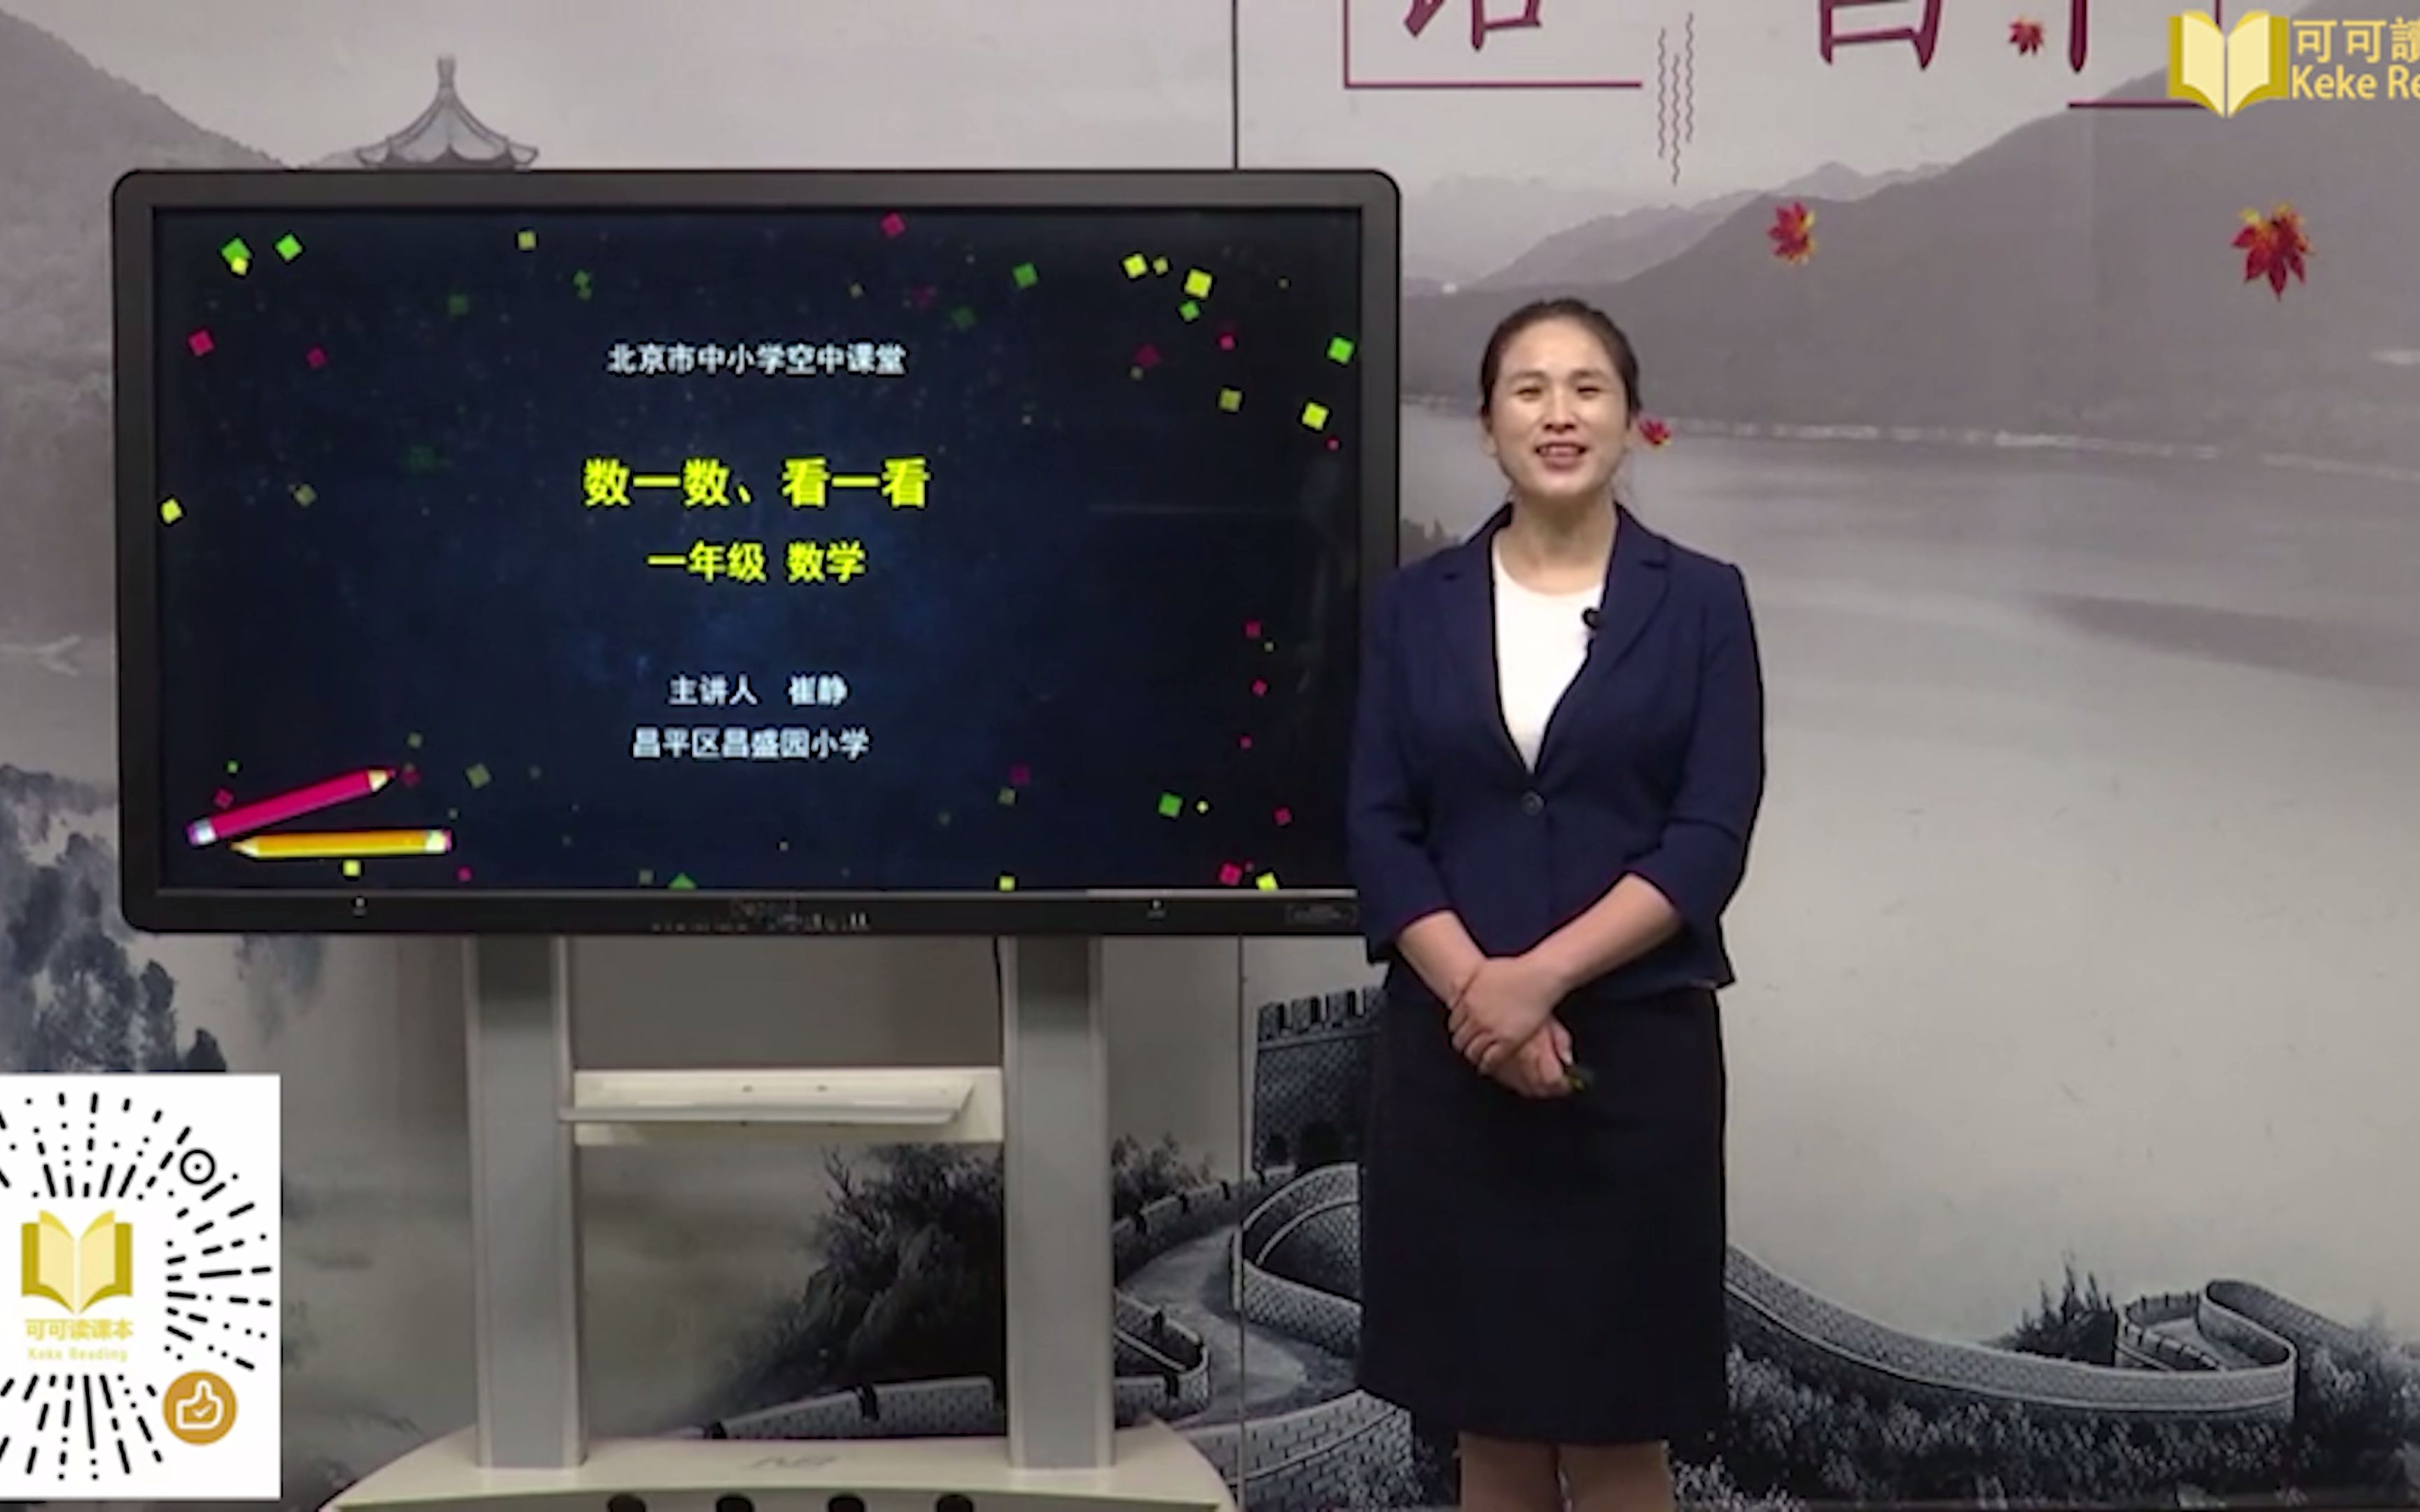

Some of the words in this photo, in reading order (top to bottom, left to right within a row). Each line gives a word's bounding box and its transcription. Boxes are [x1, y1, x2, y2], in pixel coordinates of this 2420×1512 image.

[607, 342, 907, 375] 北京市中小学空中课堂
[583, 457, 931, 508] 数一数、看一看
[647, 540, 767, 583] 一年级
[786, 540, 866, 583] 数学
[669, 674, 758, 706] 主讲人
[788, 674, 848, 706] 崔静
[632, 727, 870, 760] 昌平区昌盛园小学
